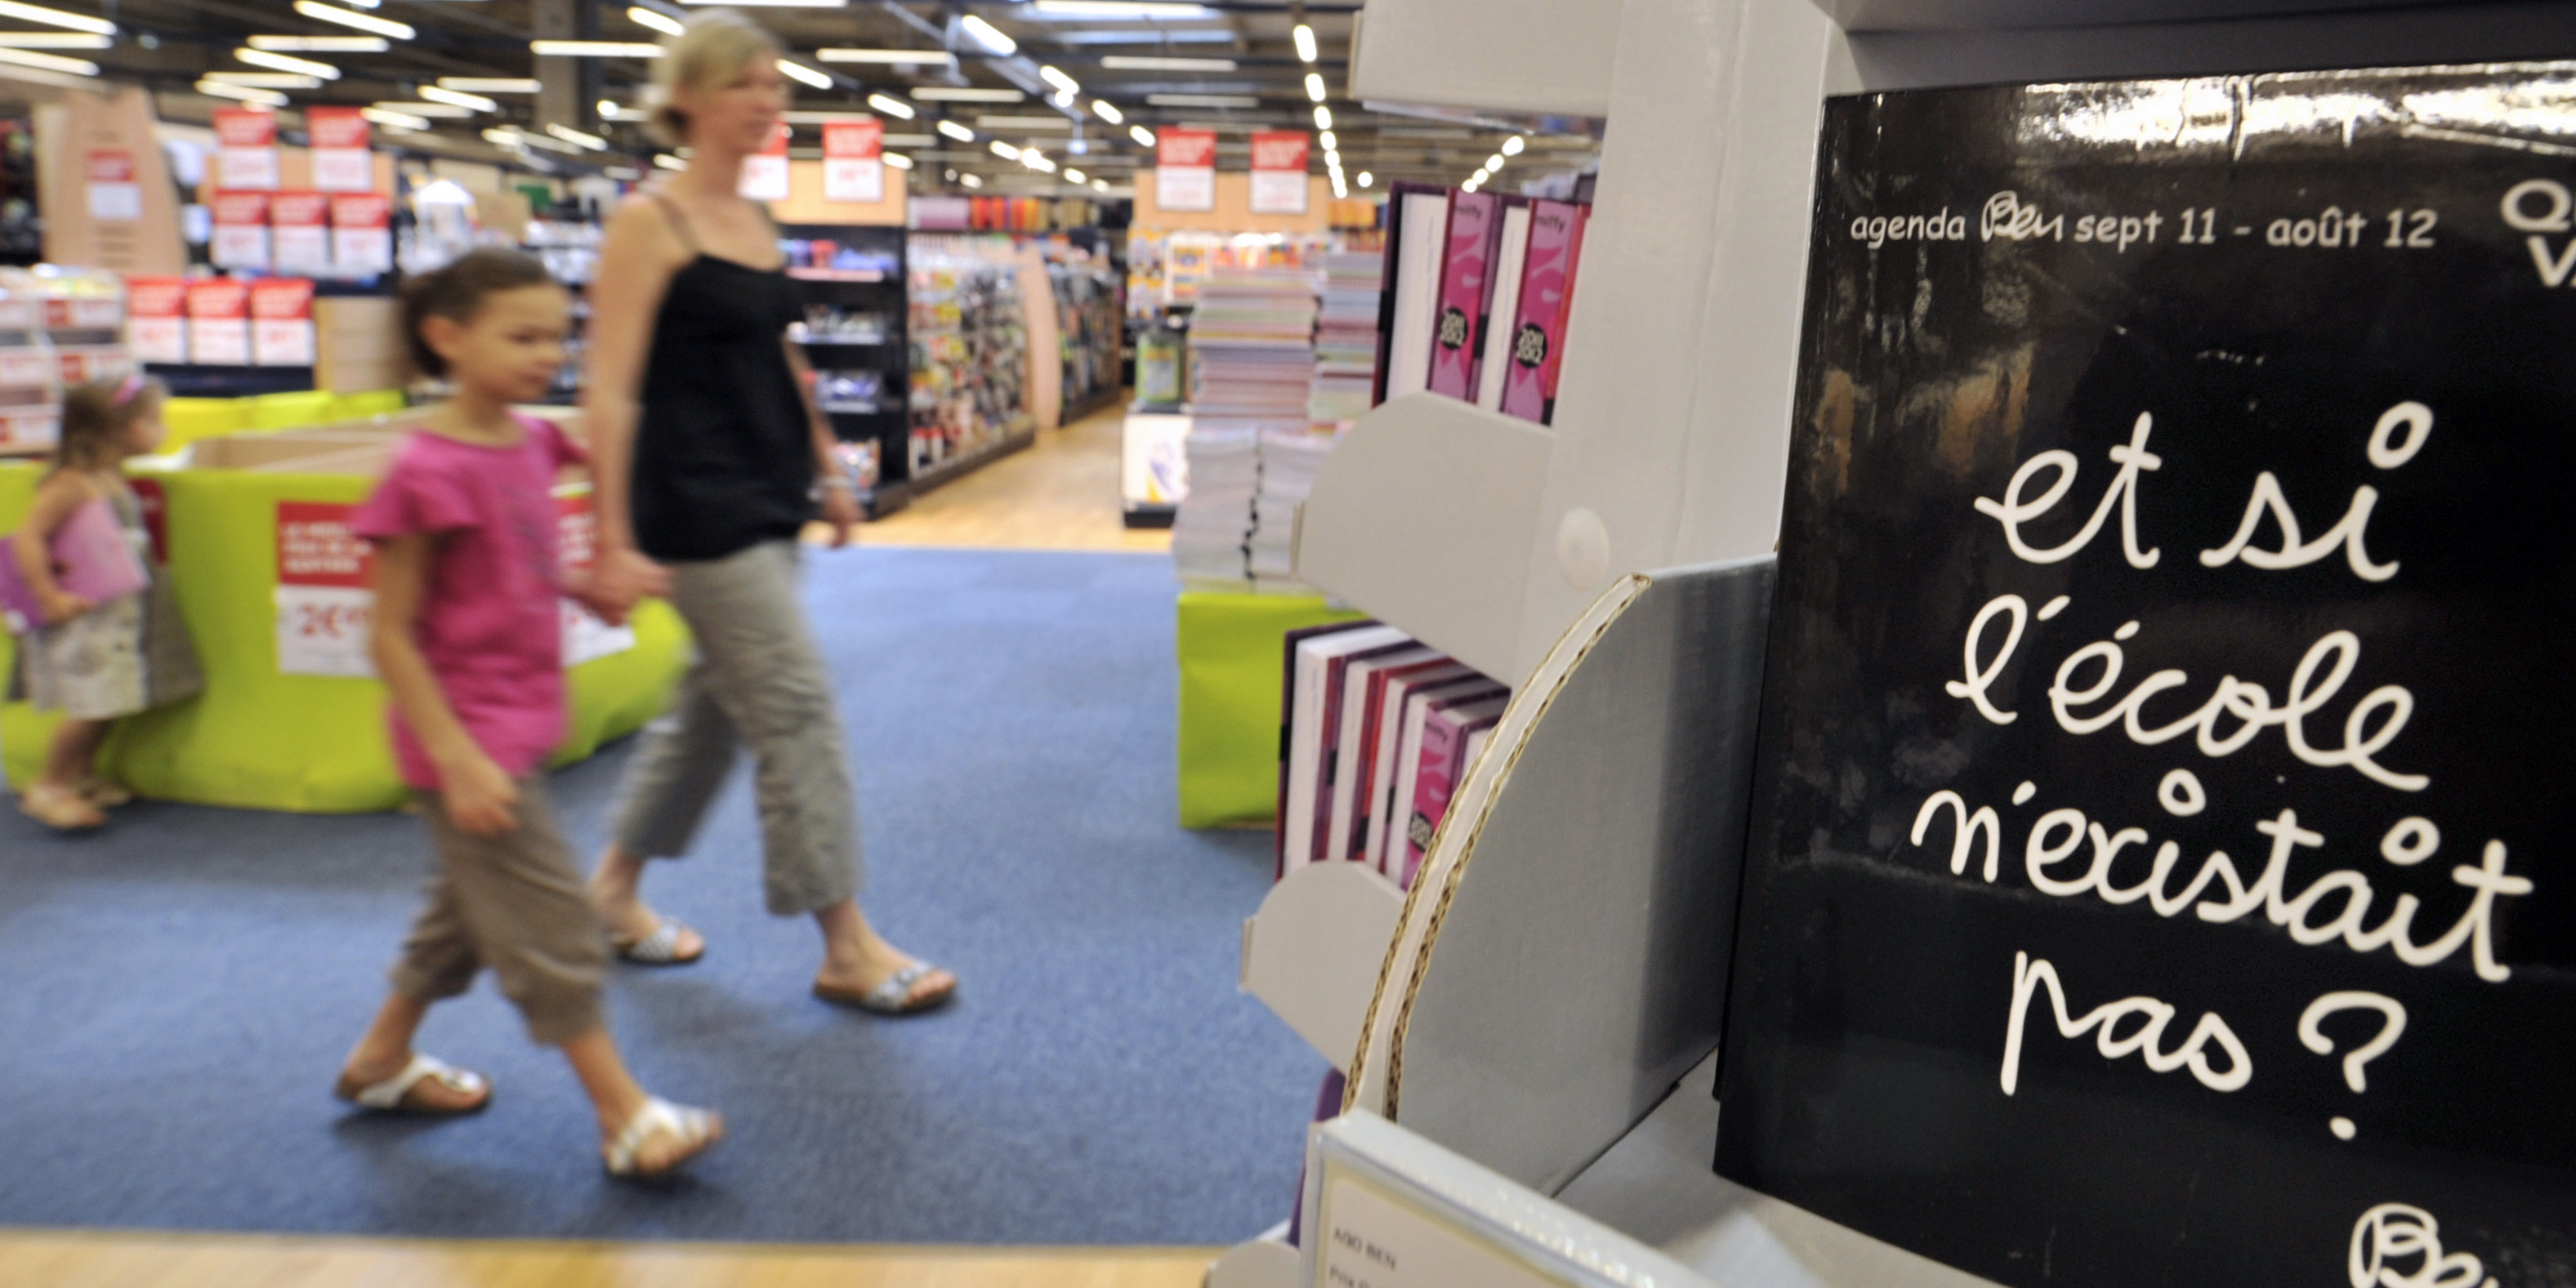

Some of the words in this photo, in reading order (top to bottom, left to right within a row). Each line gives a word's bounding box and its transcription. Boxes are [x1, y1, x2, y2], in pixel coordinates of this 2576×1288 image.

[1851, 206, 1966, 249] agenda
[1980, 190, 2064, 243] Ben
[2074, 210, 2163, 253] sept
[2179, 207, 2215, 243] 11
[2234, 226, 2251, 235] -
[2266, 206, 2366, 246] août
[2383, 209, 2438, 247] 12
[1974, 411, 2162, 569] et
[2199, 401, 2434, 582] si
[1945, 594, 2430, 791] l'école
[1910, 769, 2534, 982] n'existait
[2000, 951, 2253, 1096] pas
[2297, 991, 2408, 1140] ?
